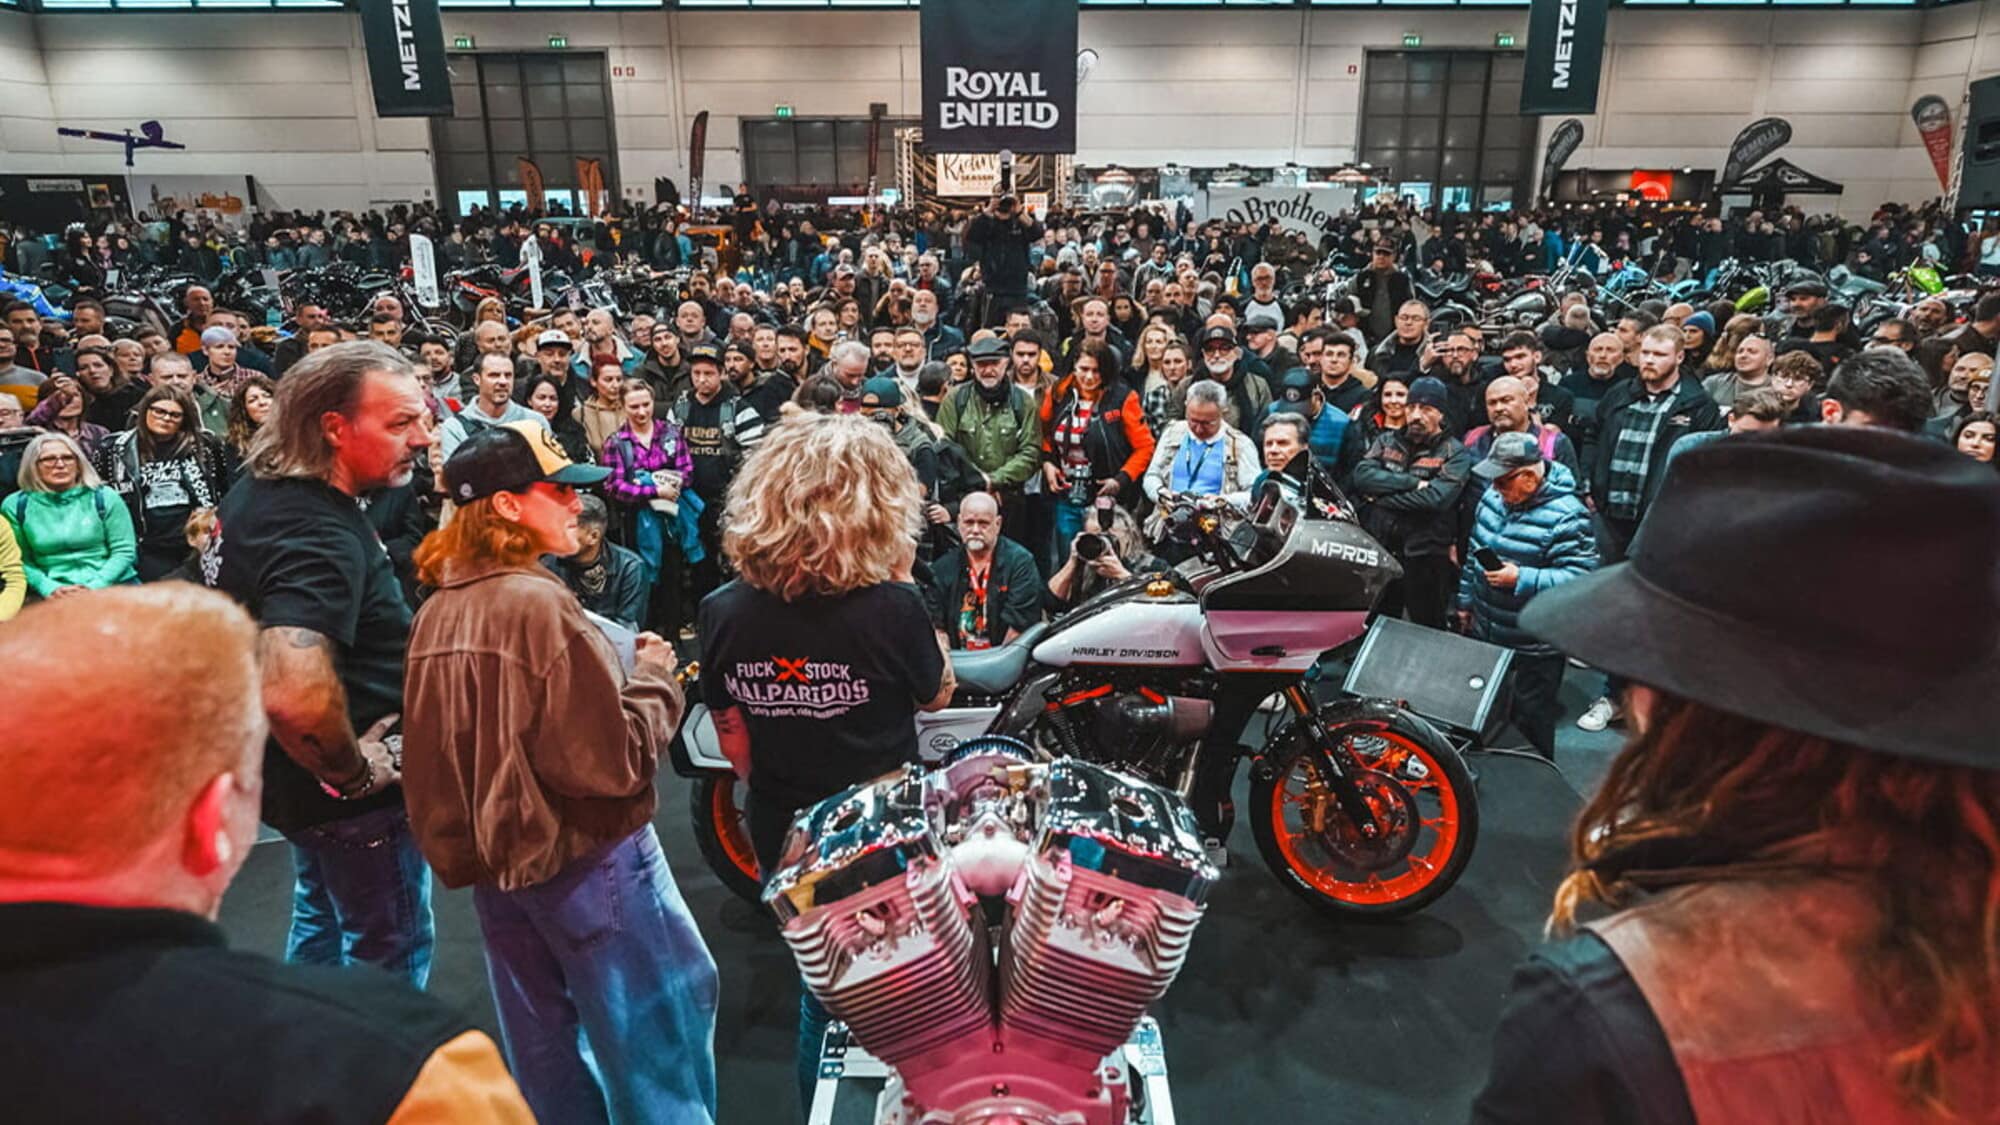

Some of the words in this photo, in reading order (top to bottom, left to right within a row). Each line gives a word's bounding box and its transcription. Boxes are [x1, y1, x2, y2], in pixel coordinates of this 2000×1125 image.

[391, 0, 421, 90] METZ
[1552, 0, 1577, 89] METZ
[946, 67, 1047, 100] ROYAL
[939, 102, 1060, 129] ENFIELD
[1311, 538, 1379, 567] MPRDS
[1071, 647, 1117, 657] HARLEY
[1119, 648, 1180, 658] DAVIDSON
[736, 661, 776, 678] FUCK
[805, 662, 851, 681] STOCK
